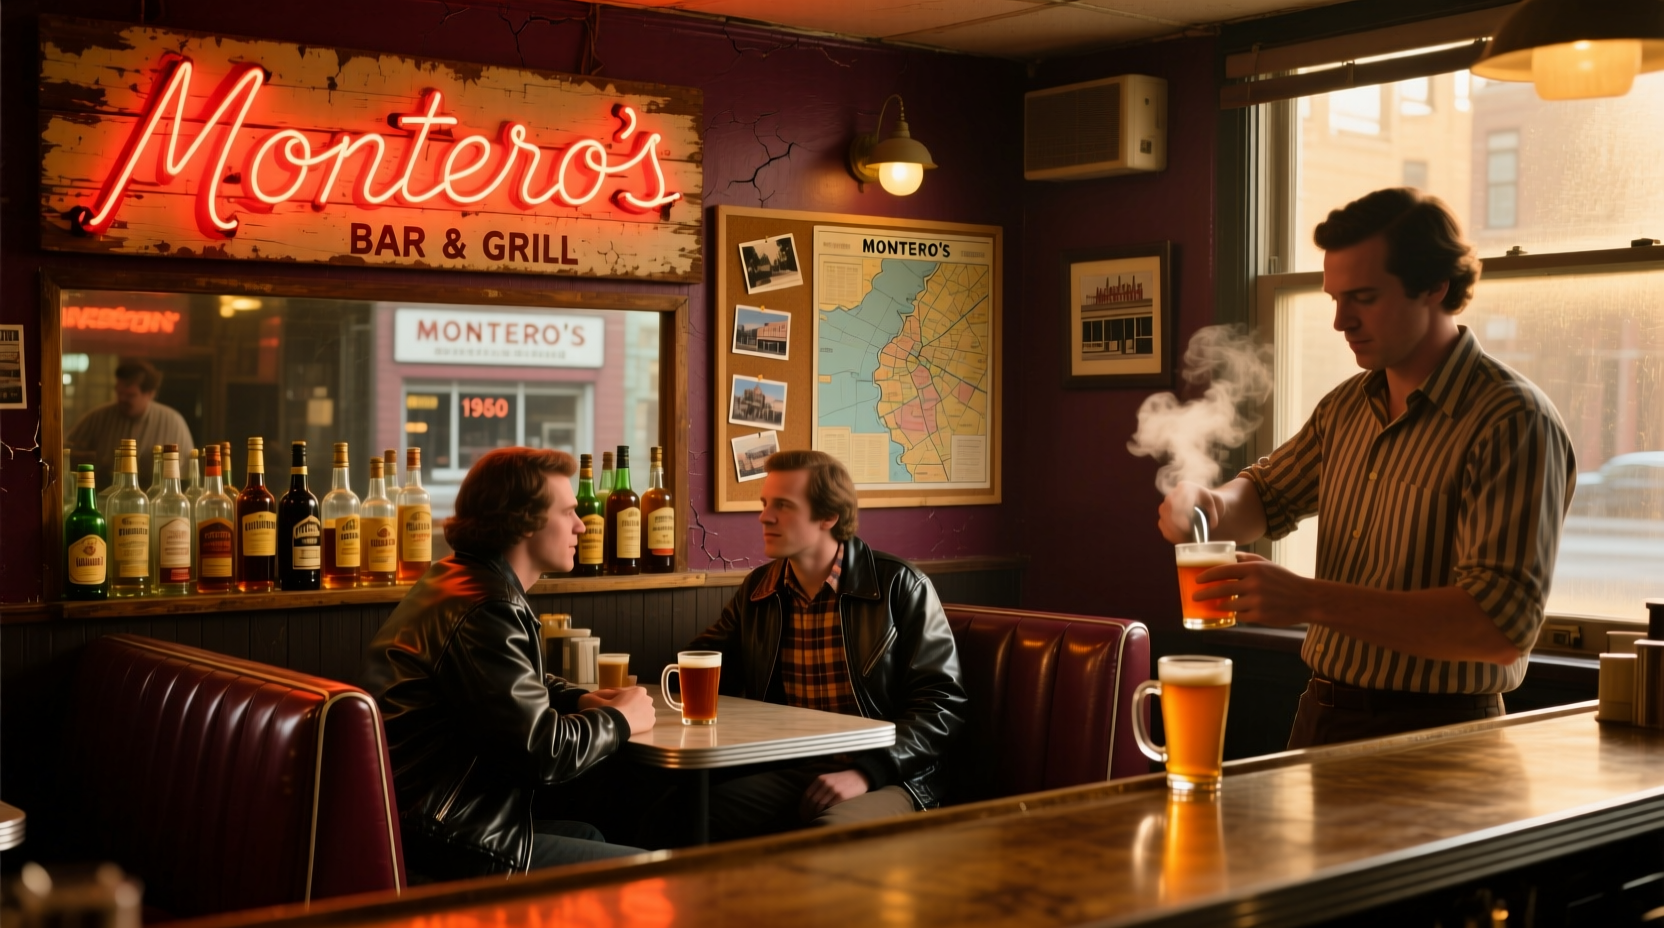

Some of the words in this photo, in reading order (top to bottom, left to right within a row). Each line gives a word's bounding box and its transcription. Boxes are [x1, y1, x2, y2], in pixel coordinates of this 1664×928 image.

[89, 60, 682, 230] Montero's
[350, 223, 425, 258] BAR
[442, 228, 466, 259] &
[482, 231, 578, 265] GRILL
[862, 238, 951, 258] MONTERO'S
[416, 319, 586, 347] MONTERO'S
[461, 397, 509, 418] 1960
